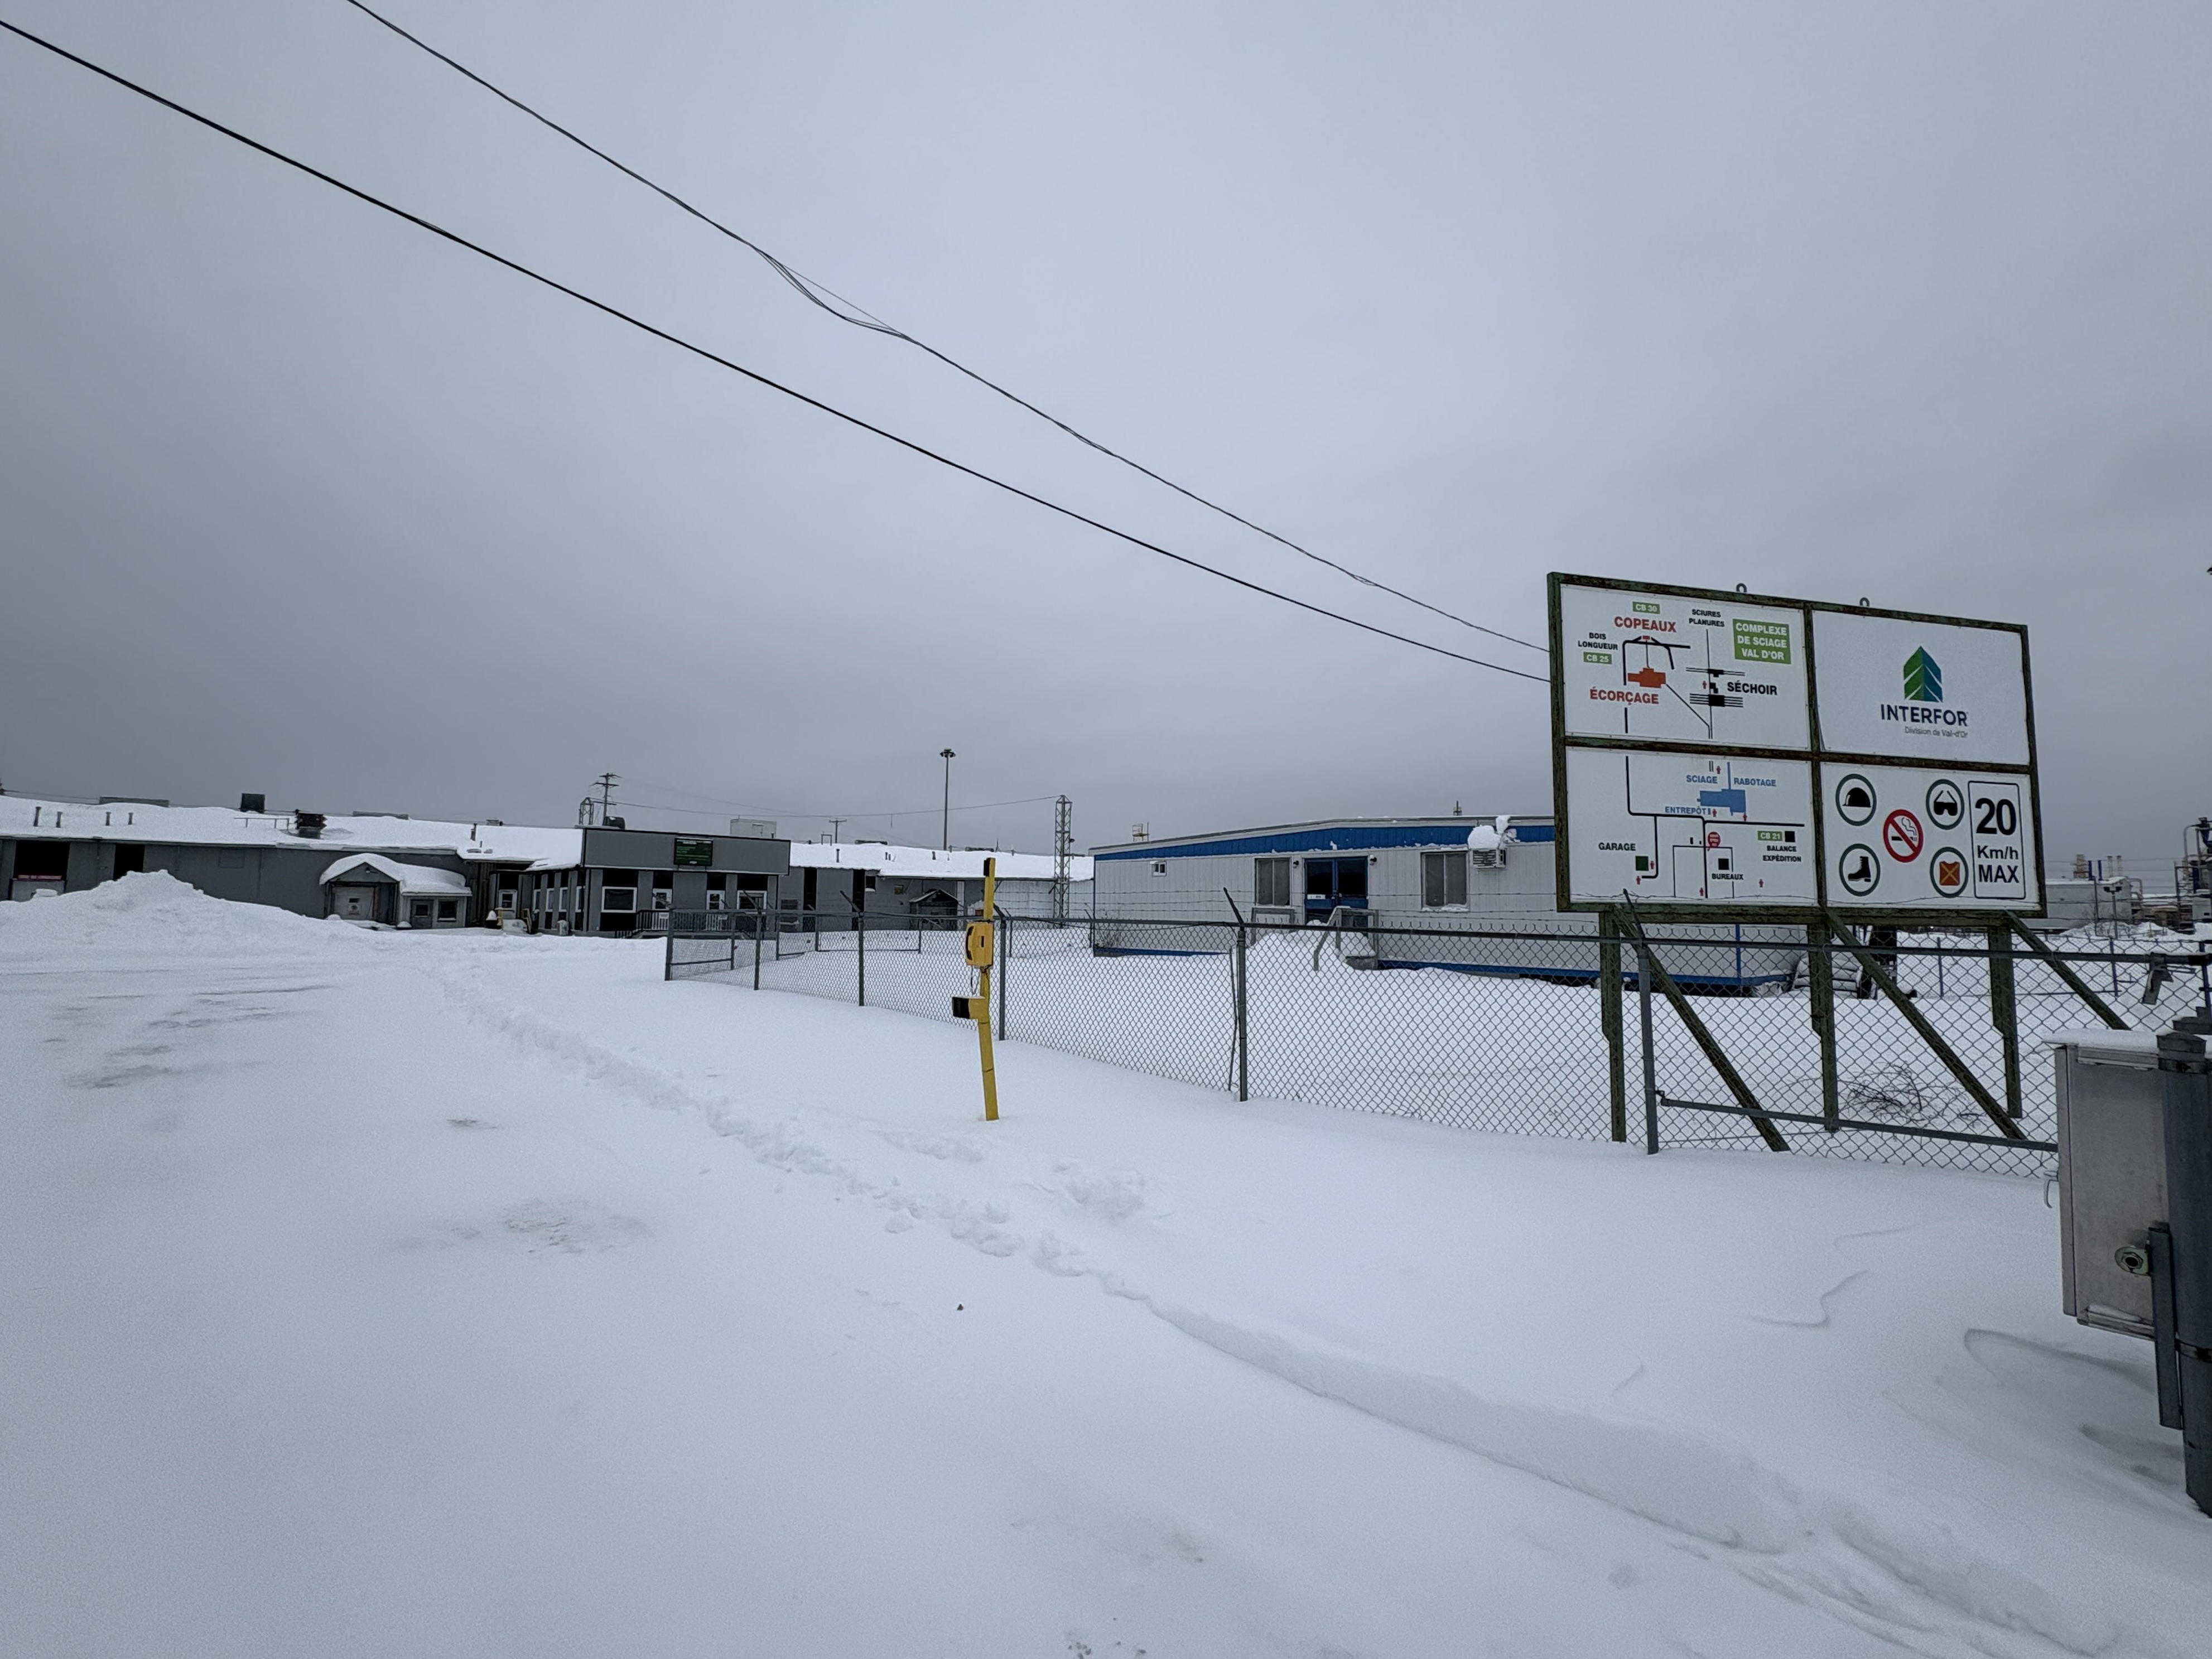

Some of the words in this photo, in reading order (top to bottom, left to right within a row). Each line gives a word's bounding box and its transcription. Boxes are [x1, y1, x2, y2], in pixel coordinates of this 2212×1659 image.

[1692, 609, 1721, 618] SCIURES
[1614, 616, 1676, 633] COPEAUX
[1689, 618, 1725, 627] PLANURES
[1736, 623, 1787, 635] COMPLEXE
[1578, 640, 1618, 650] LONGUEUR
[1737, 635, 1751, 644] DE
[1753, 637, 1787, 648] SCIAGE
[1741, 648, 1759, 658] VAL
[1761, 651, 1784, 660] D'OR
[1727, 680, 1777, 695] SÉCHOIR
[1589, 686, 1659, 705] ÉCORÇAGE
[1881, 704, 1968, 726] INTERFOR
[1686, 775, 1718, 784] SCIAGE
[1734, 778, 1776, 787] RABOTAGE
[1665, 806, 1707, 815] ENTREPÔT
[1975, 798, 2017, 836] 20
[1598, 842, 1636, 851] GARAGE
[1977, 845, 2019, 860] Km/h
[1763, 854, 1801, 862] EXPÉDITION
[1978, 864, 2020, 883] MAX
